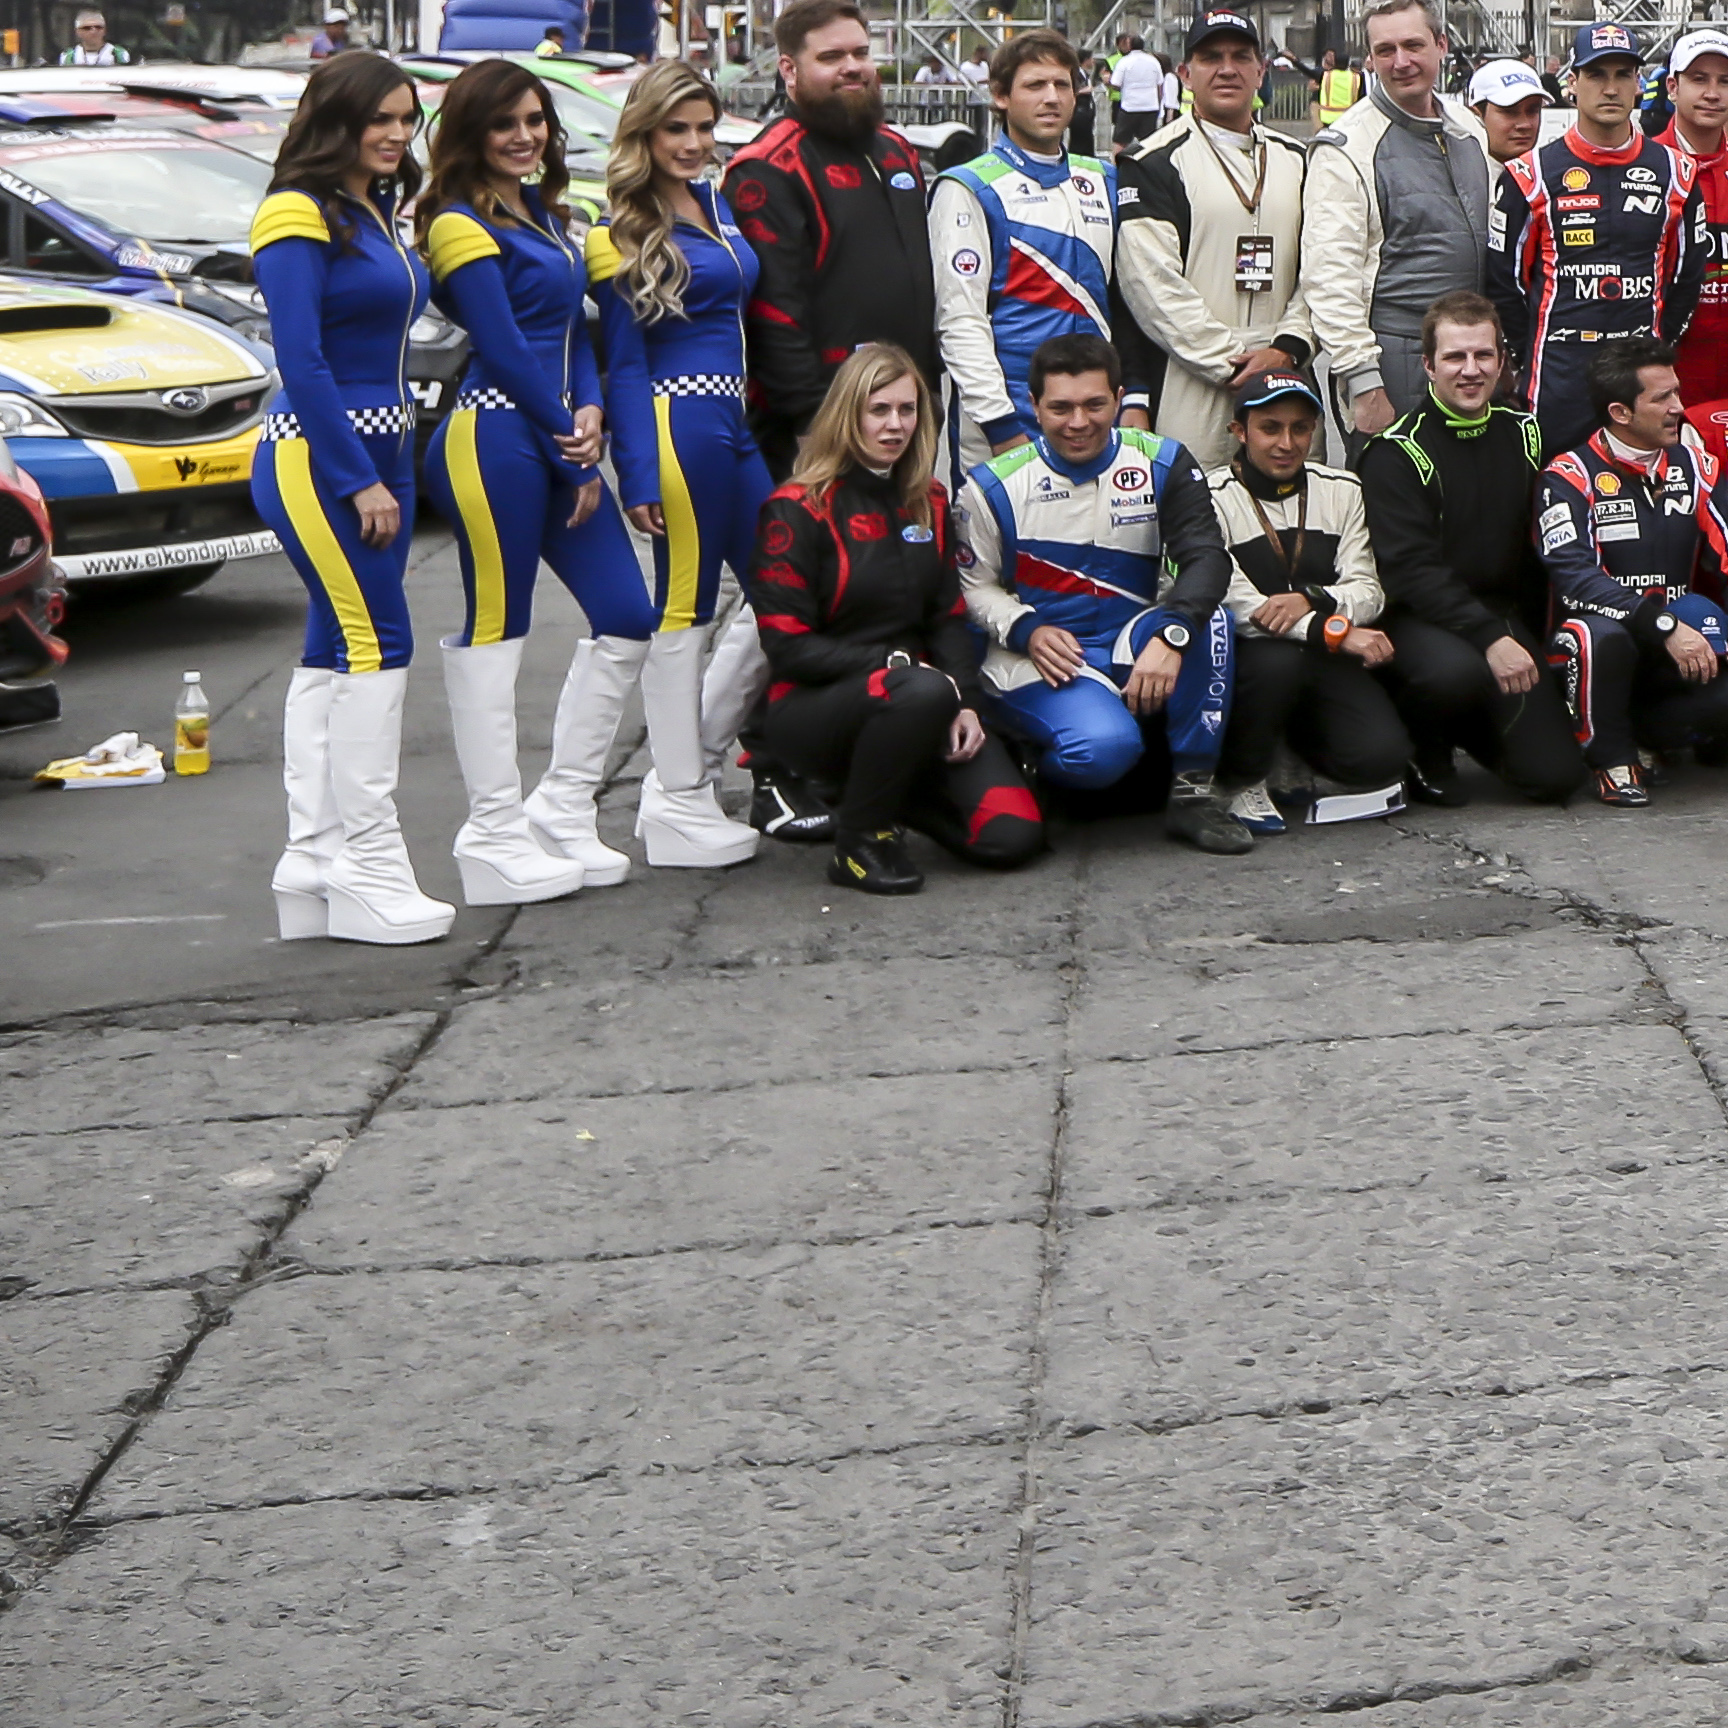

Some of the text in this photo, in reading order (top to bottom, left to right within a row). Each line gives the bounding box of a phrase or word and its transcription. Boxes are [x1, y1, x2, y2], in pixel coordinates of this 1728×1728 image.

[1565, 233, 1591, 243] RACC
[1575, 276, 1652, 300] MOBIS
[1121, 471, 1139, 487] PF
[1111, 496, 1142, 508] Mobil
